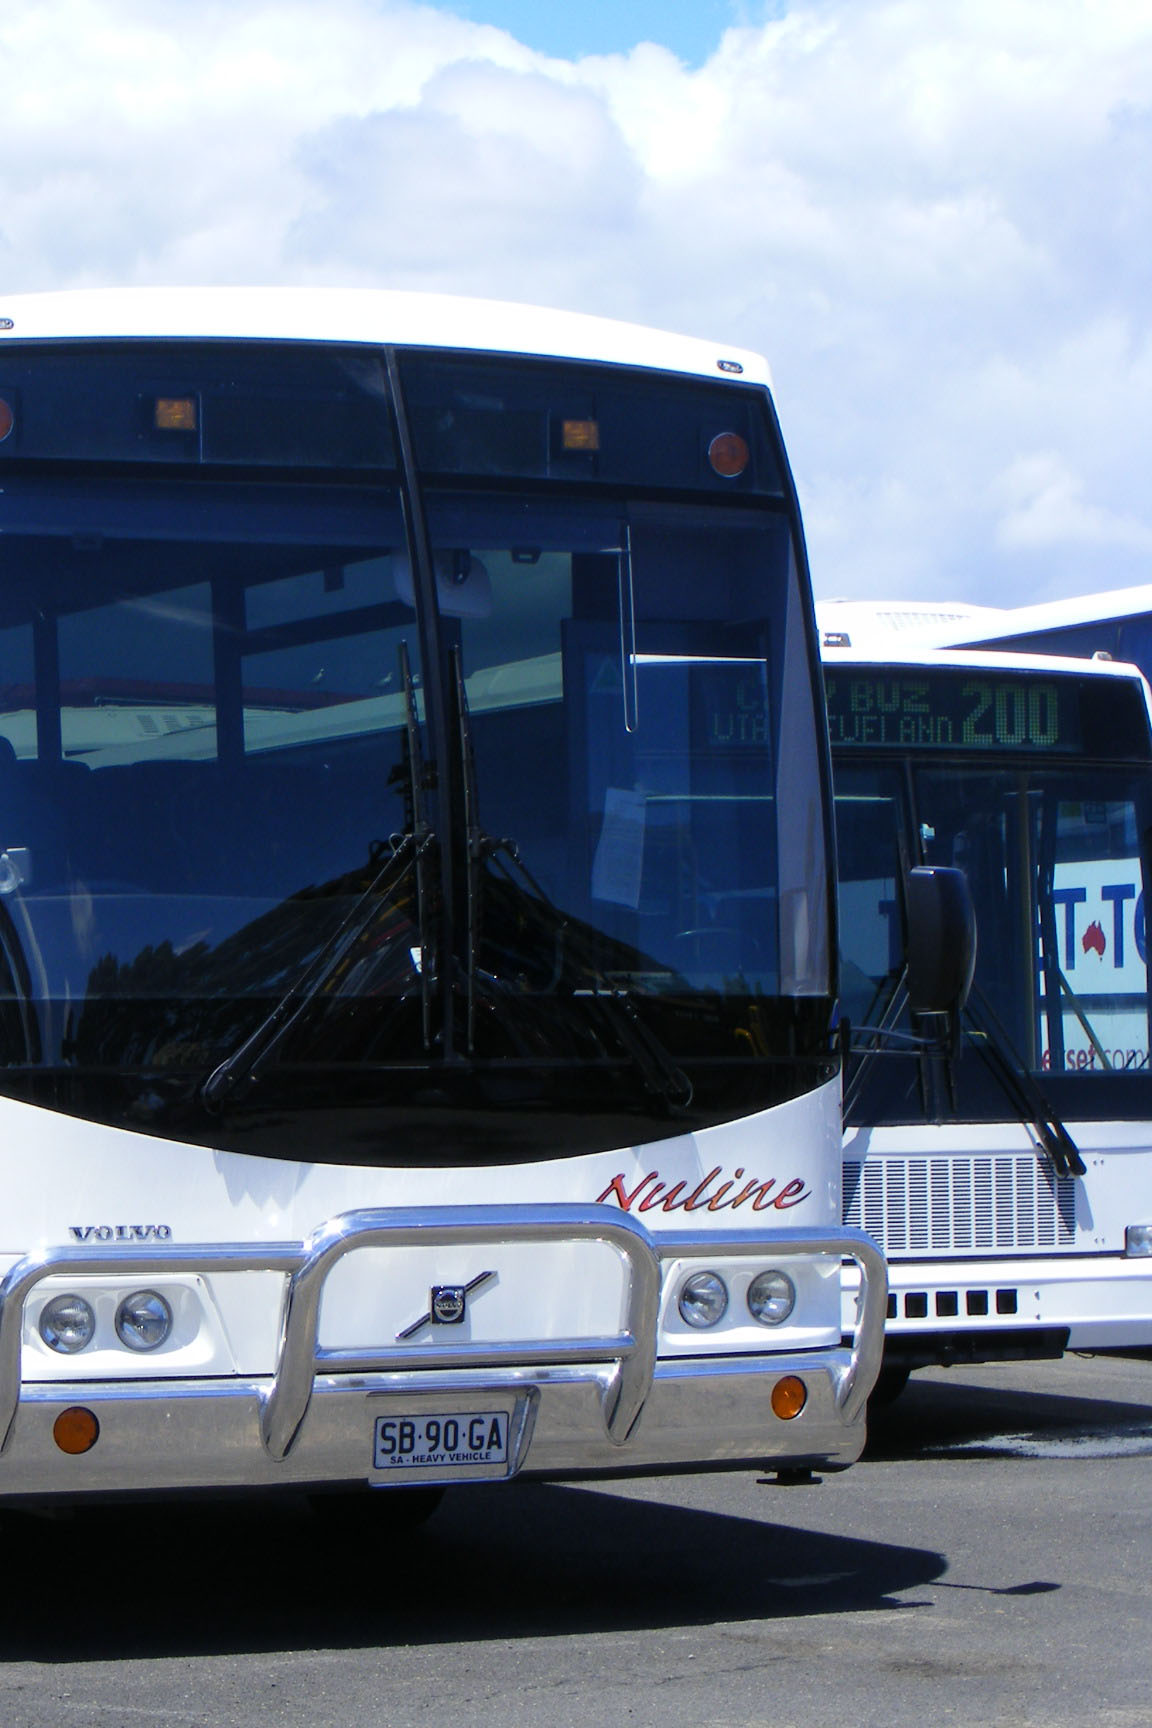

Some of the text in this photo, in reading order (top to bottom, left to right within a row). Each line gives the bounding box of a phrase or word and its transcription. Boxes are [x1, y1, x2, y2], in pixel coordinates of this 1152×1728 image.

[850, 680, 931, 713] BUZ
[962, 682, 1060, 745] 200
[596, 1165, 813, 1213] Nuline
[68, 1224, 173, 1242] VOLVO
[390, 1455, 404, 1465] SA
[412, 1453, 446, 1464] HEAVY
[450, 1451, 492, 1462] VEHICLE
